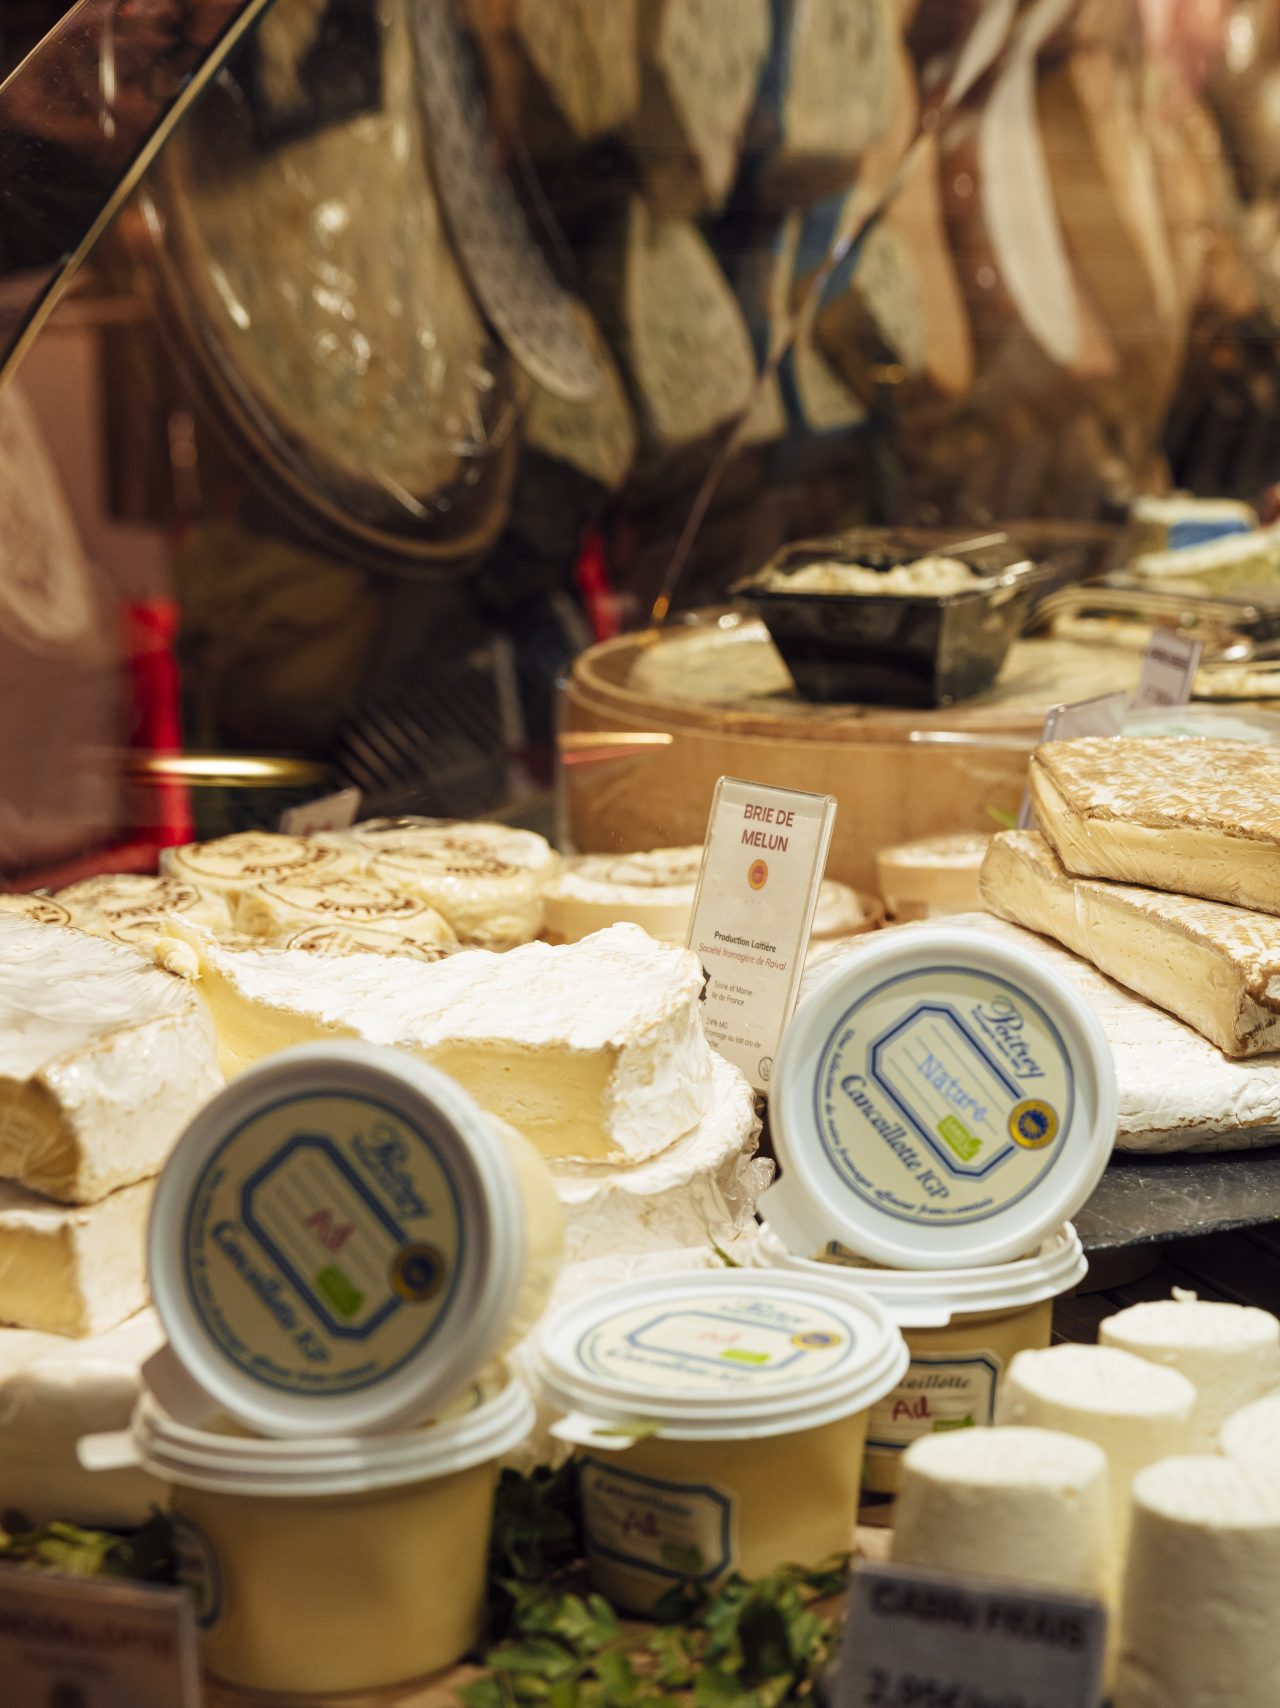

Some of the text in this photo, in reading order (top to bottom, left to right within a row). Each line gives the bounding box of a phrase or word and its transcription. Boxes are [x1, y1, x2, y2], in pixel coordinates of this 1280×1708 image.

[743, 804, 795, 828] BRIE DE
[741, 829, 789, 853] MELUN
[714, 930, 750, 946] Production
[699, 943, 722, 956] Société
[722, 947, 754, 964] fromagère
[756, 956, 765, 966] de
[718, 993, 726, 1001] de
[727, 995, 745, 1006] France
[975, 996, 1045, 1079] Poitrey
[917, 1052, 988, 1122] Nature
[841, 1073, 951, 1200] Cancoillotte IGP
